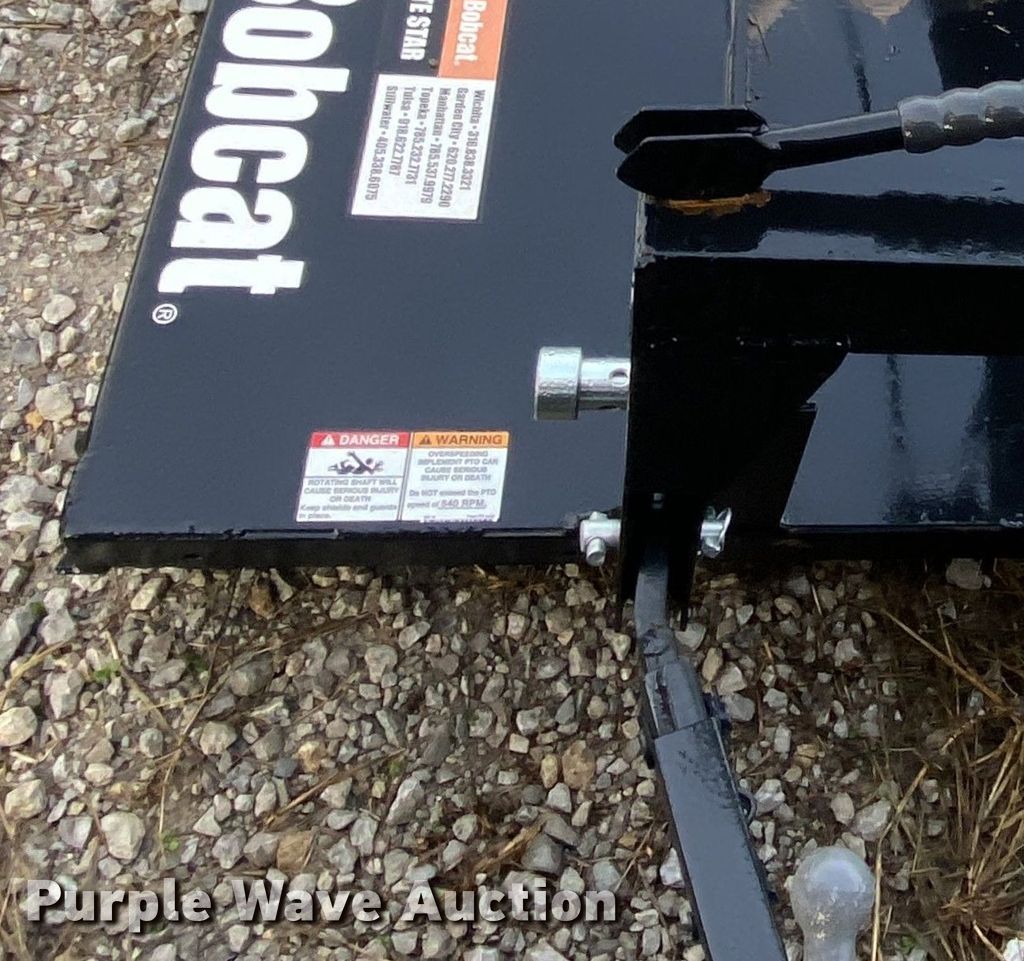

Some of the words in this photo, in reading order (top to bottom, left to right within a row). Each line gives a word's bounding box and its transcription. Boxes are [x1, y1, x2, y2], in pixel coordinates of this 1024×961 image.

[401, 15, 432, 61] STAR
[456, 0, 487, 64] Bobcat
[380, 85, 399, 130] Stillwater
[403, 86, 416, 112] Tulsa
[420, 87, 434, 120] Topeka
[433, 87, 452, 136] Manhattan
[456, 87, 469, 120] Garden
[469, 89, 485, 123] Wichita
[452, 121, 465, 140] City
[339, 433, 400, 446] DANGER
[435, 434, 502, 446] WARNING
[440, 499, 459, 507] 540
[480, 488, 497, 496] PTO
